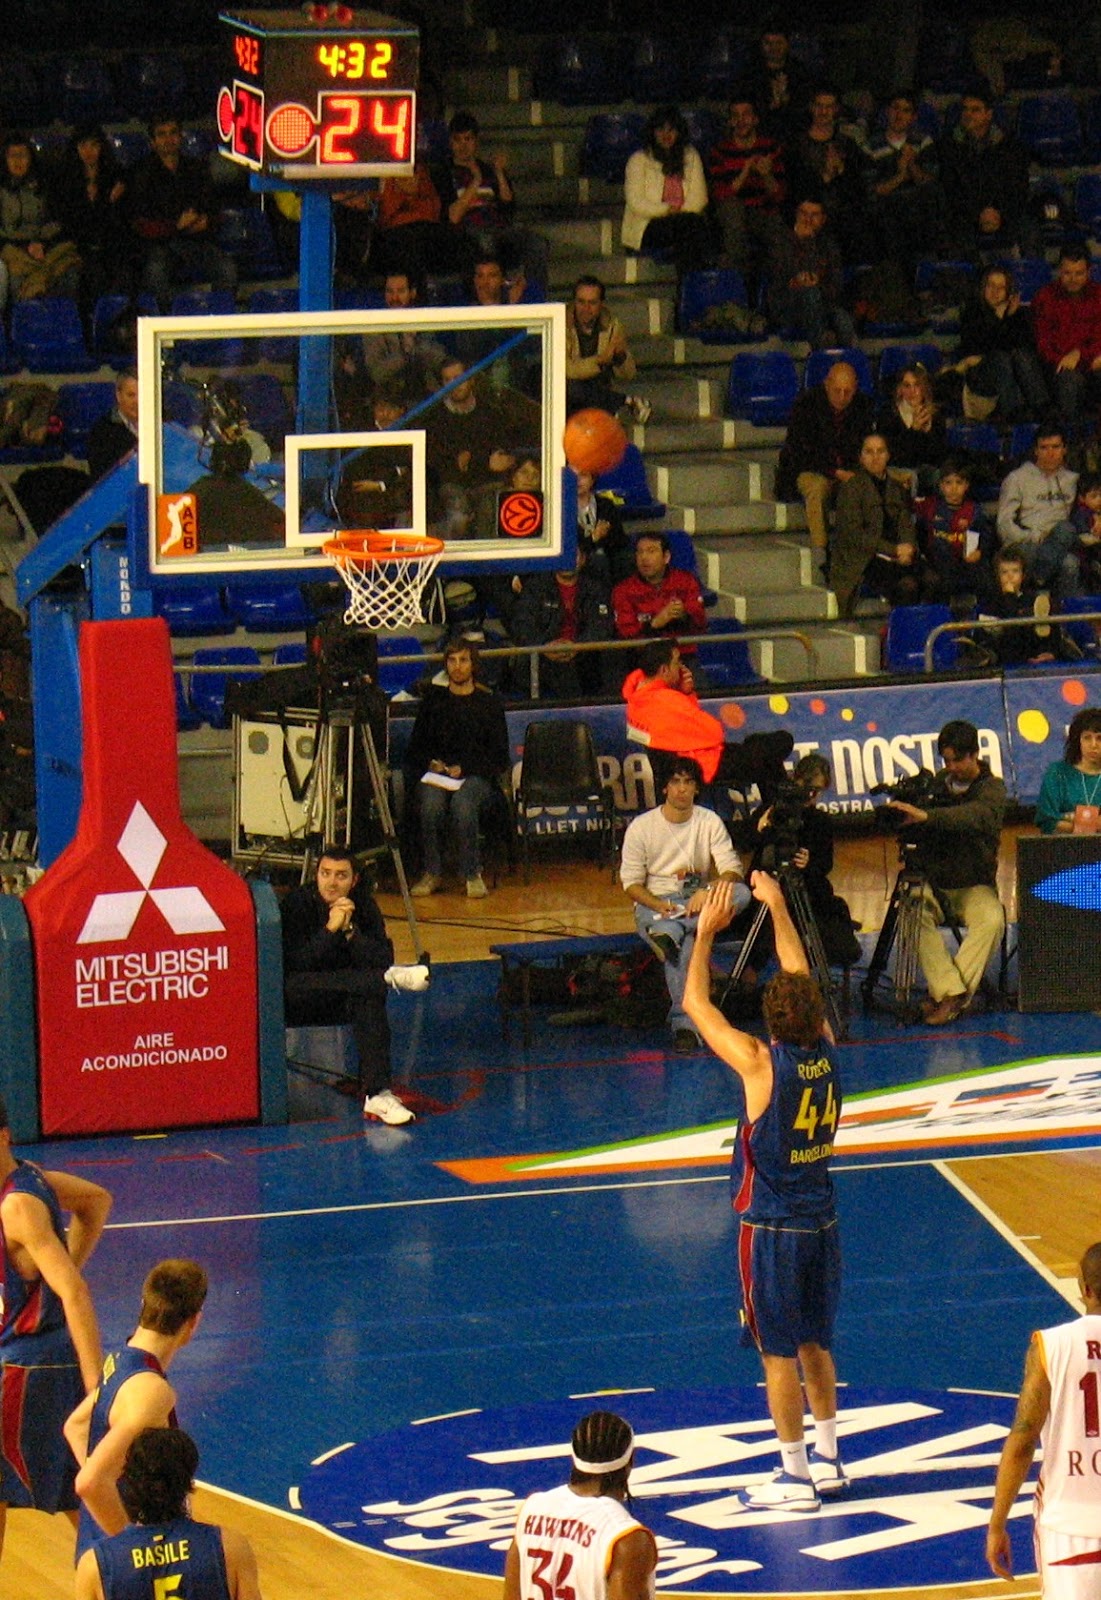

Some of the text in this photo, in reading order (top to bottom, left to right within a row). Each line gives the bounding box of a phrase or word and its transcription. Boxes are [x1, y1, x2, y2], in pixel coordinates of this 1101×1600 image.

[319, 43, 392, 78] 4:32
[322, 98, 408, 162] 24
[183, 506, 194, 549] ACB
[535, 818, 579, 835] LLET
[815, 799, 875, 815] OSTRA
[75, 945, 229, 983] MITSUBISHI
[76, 973, 209, 1008] ELECTRIC
[133, 1032, 174, 1050] AIRE
[80, 1045, 228, 1073] ACONDICIONADO
[792, 1082, 837, 1140] 44
[790, 1143, 833, 1165] BARCELON
[524, 1514, 597, 1548] HAWKINS
[131, 1540, 190, 1568] BASILE
